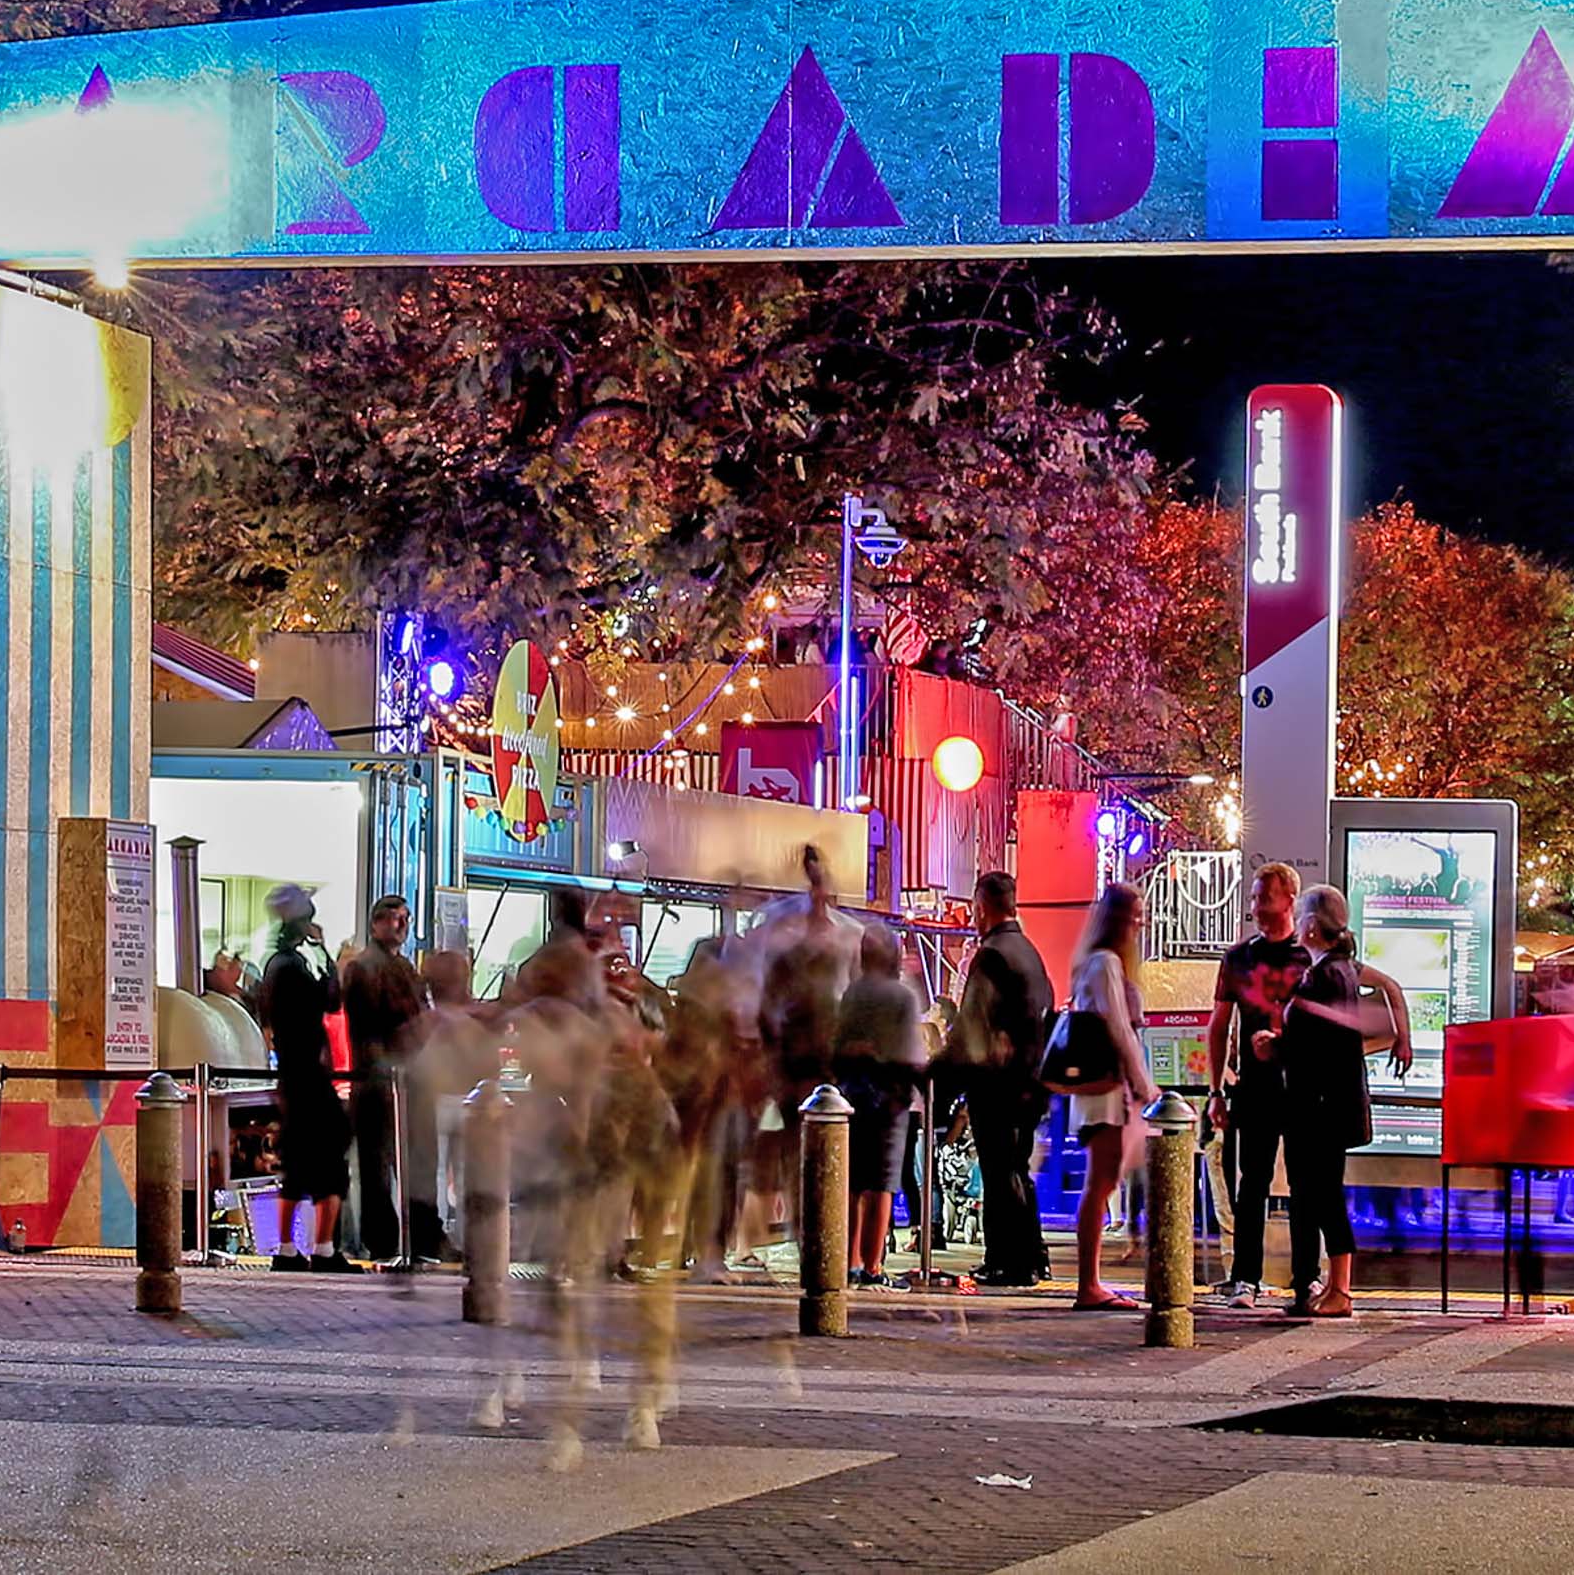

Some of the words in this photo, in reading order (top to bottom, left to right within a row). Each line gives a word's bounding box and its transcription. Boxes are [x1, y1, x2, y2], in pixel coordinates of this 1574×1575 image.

[512, 764, 540, 791] PIZZA
[107, 837, 151, 857] ARCADIA
[1164, 1015, 1199, 1025] ARCADIA
